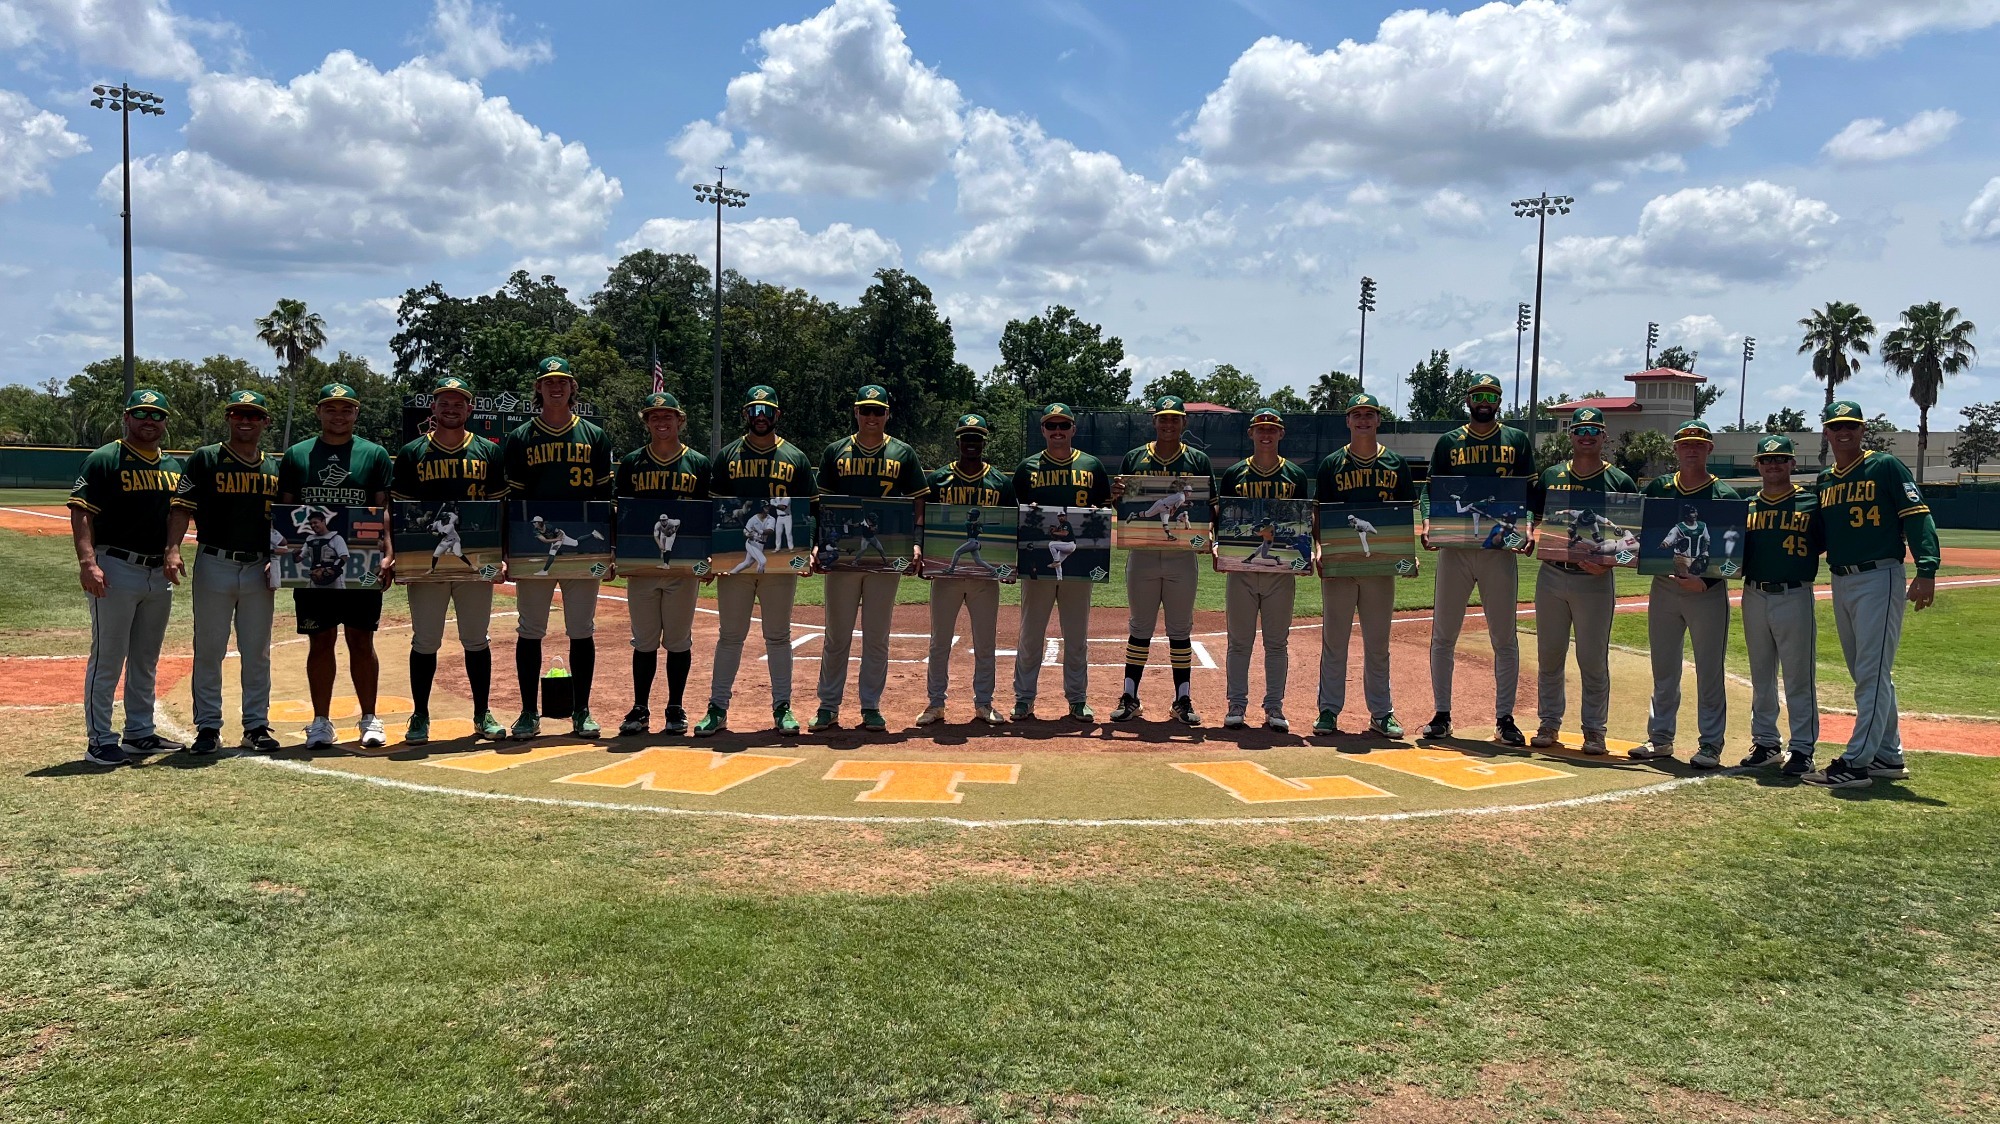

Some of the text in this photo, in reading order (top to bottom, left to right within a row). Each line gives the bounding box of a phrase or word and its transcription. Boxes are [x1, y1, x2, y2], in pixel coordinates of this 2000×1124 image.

[527, 442, 592, 466] SAINT LEO
[1450, 445, 1516, 467] SAINT LEO
[417, 458, 487, 482] SAINT LEO
[569, 466, 594, 487] 33
[729, 459, 795, 483] SAINT LEO
[836, 458, 901, 479] SAINT LEO
[1030, 469, 1094, 489] SAINT LEO
[120, 470, 181, 492] SAINT LE
[216, 472, 279, 496] SAINT LE
[632, 471, 698, 493] SAINT LEO
[879, 481, 894, 498] 7
[1235, 481, 1296, 499] SAINT LEO
[1335, 469, 1398, 491] SAINT LEO
[301, 487, 366, 502] SAINT LEO
[939, 486, 1000, 506] SAINT LEO
[1075, 490, 1088, 507] 8
[1820, 483, 1846, 509] AINT
[1846, 480, 1876, 503] LEO
[1746, 510, 1811, 533] AINT LEO
[1849, 505, 1880, 528] 34
[1782, 534, 1808, 557] 45
